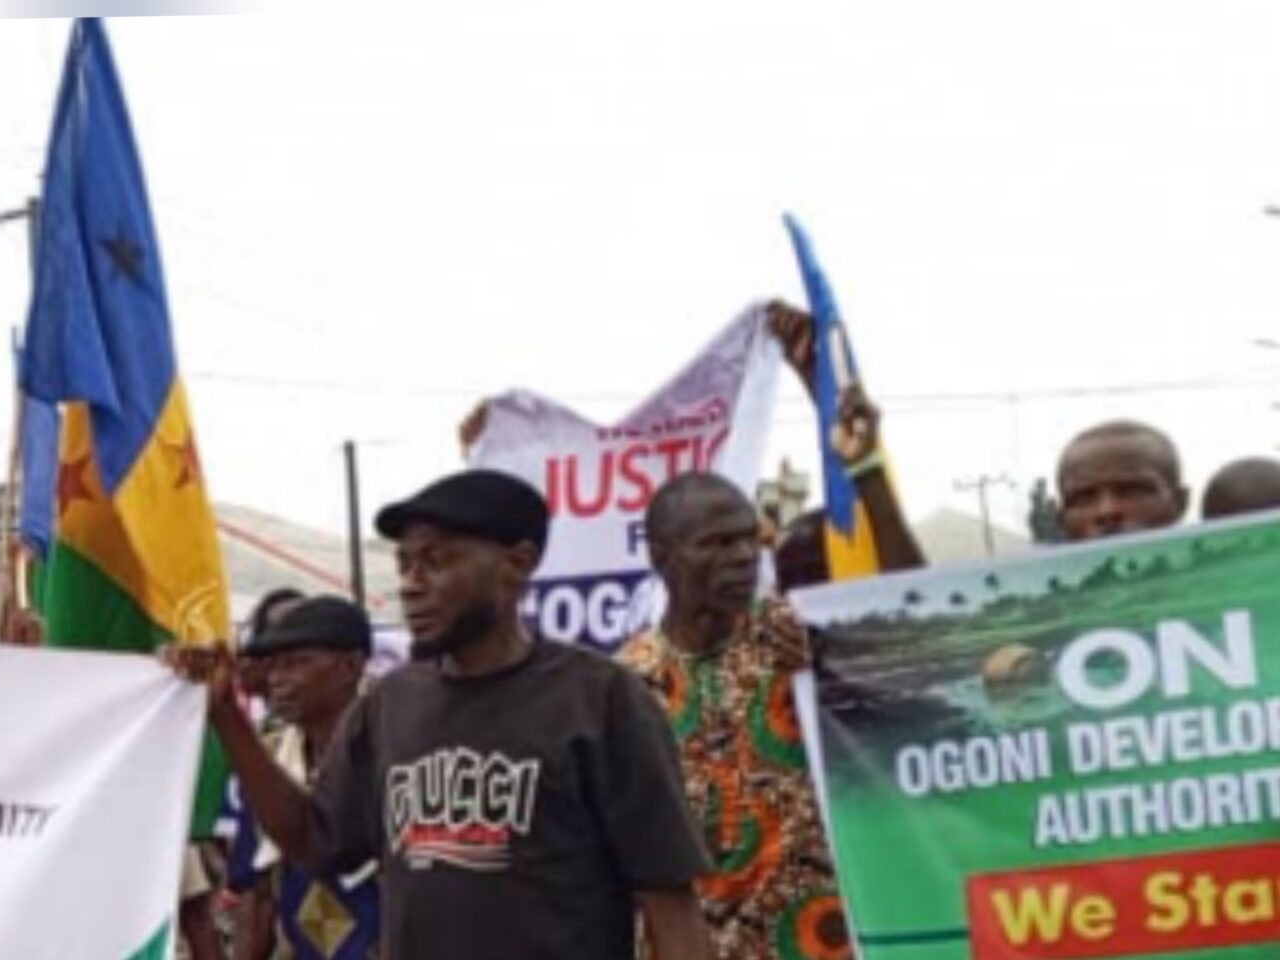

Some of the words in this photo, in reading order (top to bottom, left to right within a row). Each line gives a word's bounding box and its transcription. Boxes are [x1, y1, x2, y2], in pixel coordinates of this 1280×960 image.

[1058, 609, 1258, 709] ON
[385, 746, 542, 856] GUCCI
[896, 726, 1052, 798] OGONI
[991, 884, 1117, 944] We
[1145, 870, 1280, 933] Sta
